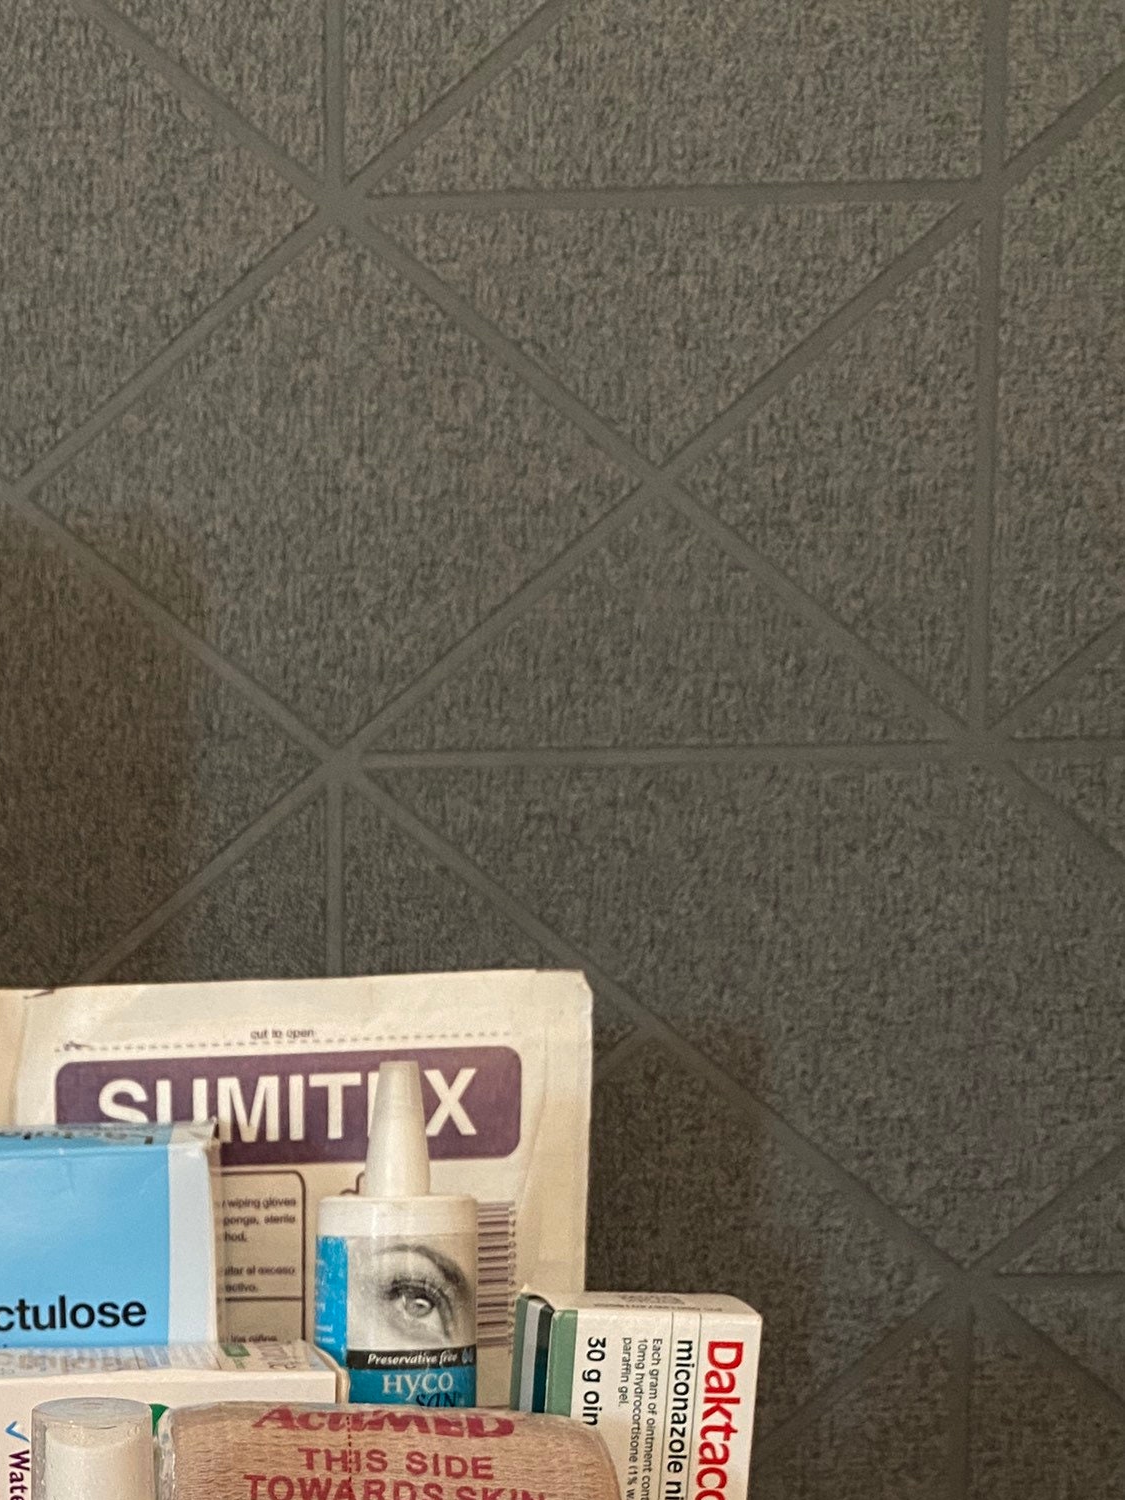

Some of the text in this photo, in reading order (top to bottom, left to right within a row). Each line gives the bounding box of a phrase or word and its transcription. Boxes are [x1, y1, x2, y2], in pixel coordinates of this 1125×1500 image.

[249, 1029, 268, 1040] cut
[285, 1028, 314, 1040] open
[97, 1067, 478, 1143] SUMITX
[262, 1196, 297, 1209] gloves
[367, 1348, 458, 1368] Preservative free
[586, 1336, 607, 1362] 30
[633, 1338, 649, 1370] 10mg
[650, 1337, 663, 1364] Each
[581, 1368, 601, 1383] g
[618, 1336, 632, 1408] paraffin gel.
[647, 1368, 660, 1401] gram
[626, 1371, 646, 1464] hydrocortisone
[647, 1402, 657, 1415] of
[667, 1339, 696, 1473] miconazole
[643, 1416, 657, 1473] ointment
[297, 1447, 495, 1481] THIS SIDE
[626, 1465, 638, 1487] (1%
